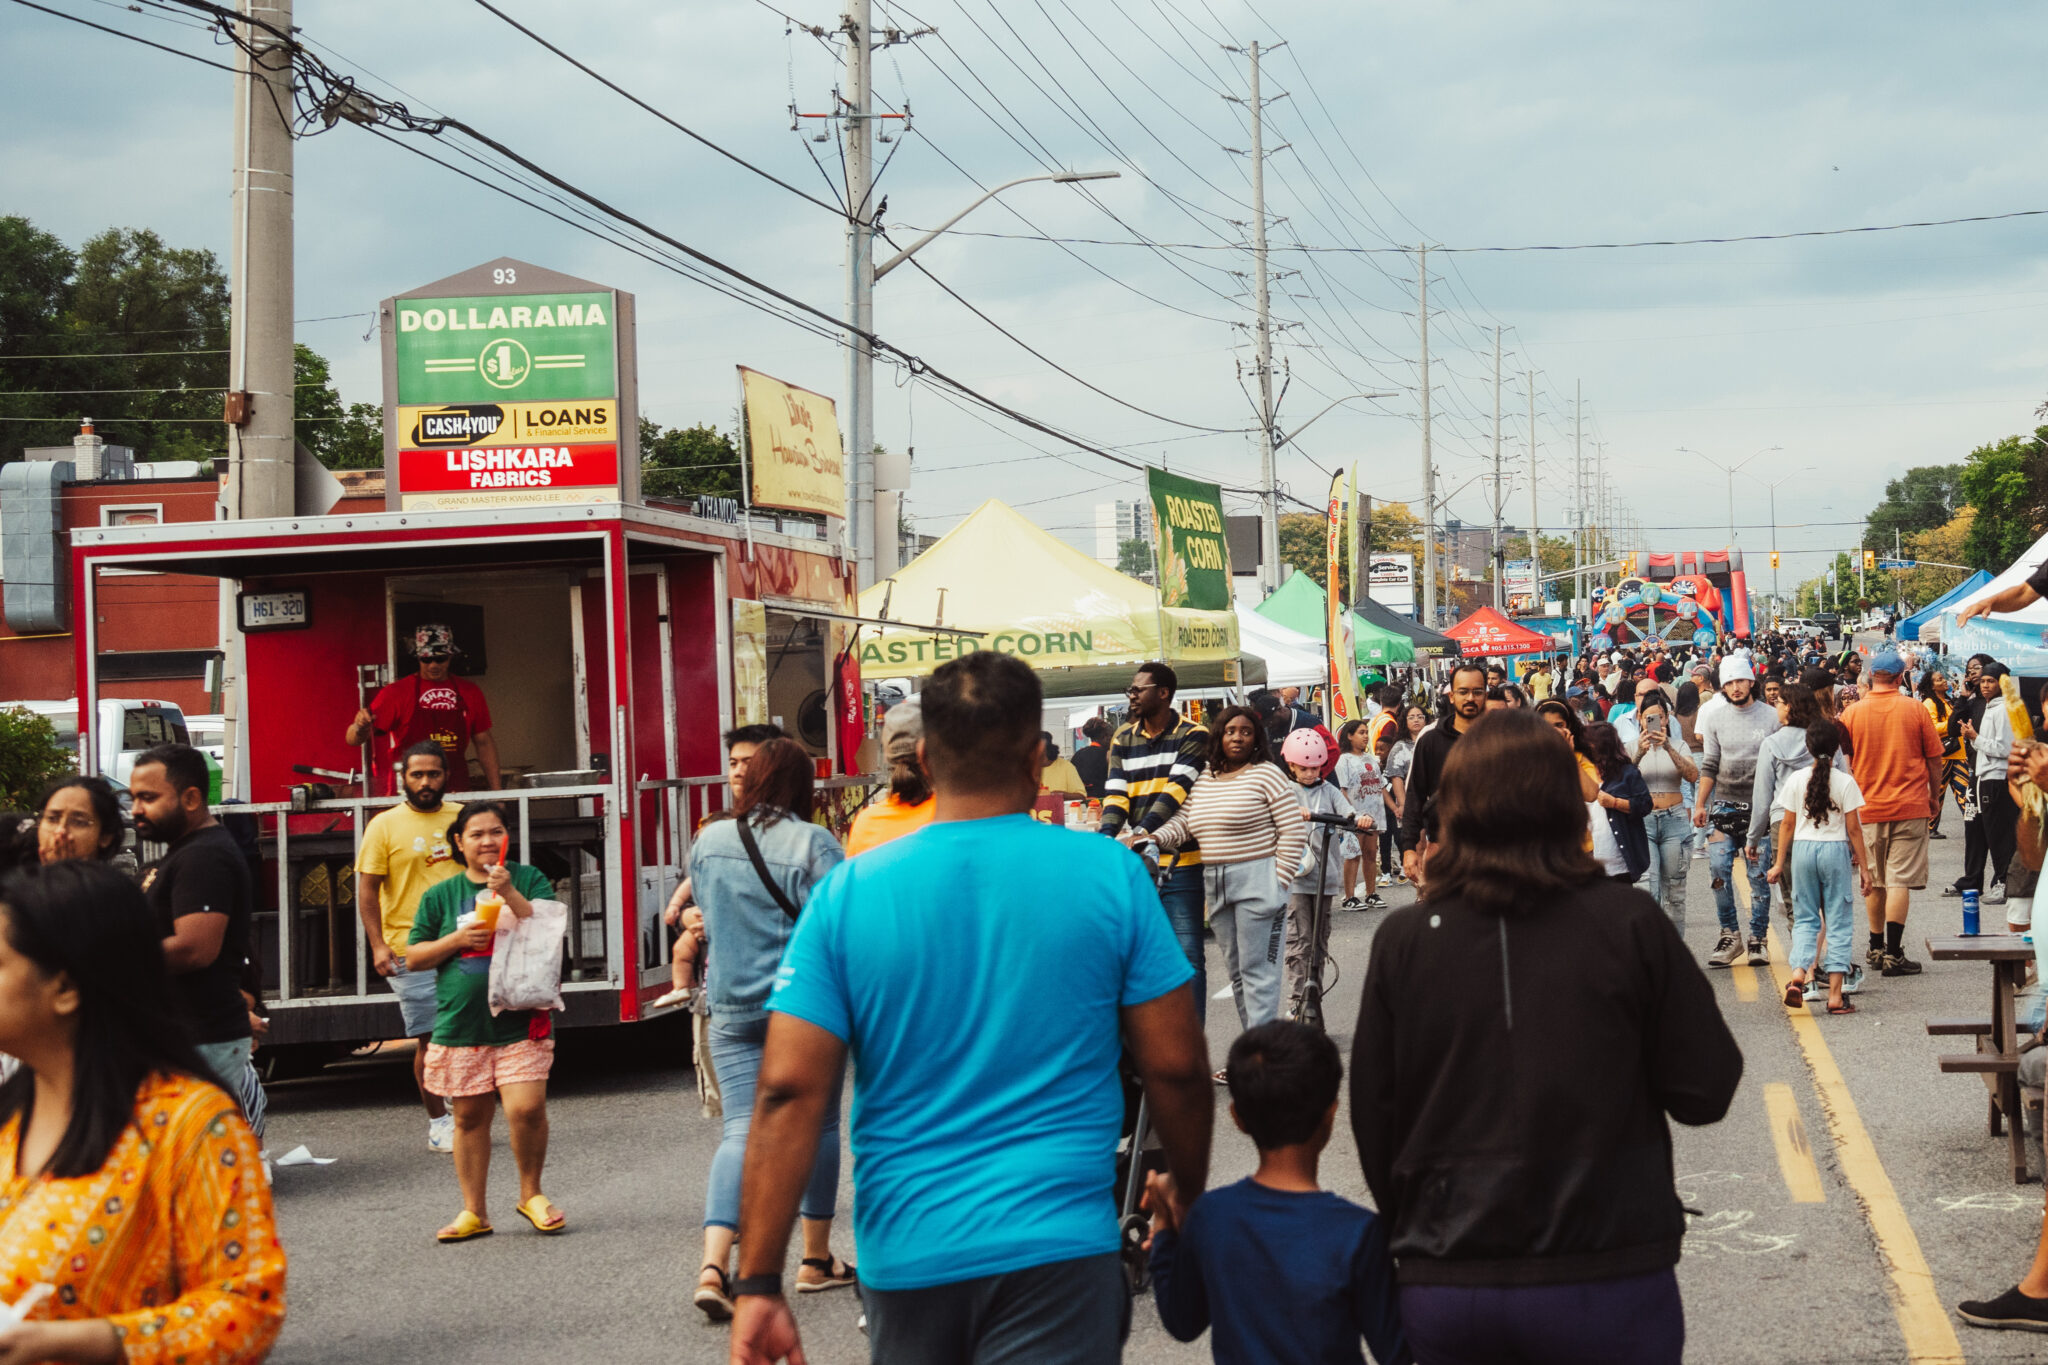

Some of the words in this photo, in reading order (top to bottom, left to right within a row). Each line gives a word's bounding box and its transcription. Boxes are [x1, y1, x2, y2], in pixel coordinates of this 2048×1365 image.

[493, 268, 517, 285] 93
[400, 303, 608, 333] DOLLARAMA
[425, 415, 499, 437] CASH4YOU
[526, 407, 608, 428] LOANS
[526, 429, 533, 437] &
[534, 427, 573, 438] Financial
[573, 426, 608, 436] Services
[446, 446, 575, 472] LISHKARA
[469, 469, 552, 489] FABRICS
[437, 495, 470, 506] GRAND
[470, 494, 509, 505] MASTER
[509, 493, 543, 504] KWANG
[543, 493, 561, 503] LEE
[1165, 494, 1223, 535] ROASTED
[1186, 535, 1224, 571] CORN
[992, 629, 1094, 656] CORN
[1178, 626, 1211, 649] ROASTED
[1211, 626, 1229, 648] CORN
[1953, 636, 2001, 652] Bubble
[2006, 640, 2031, 651] Tea
